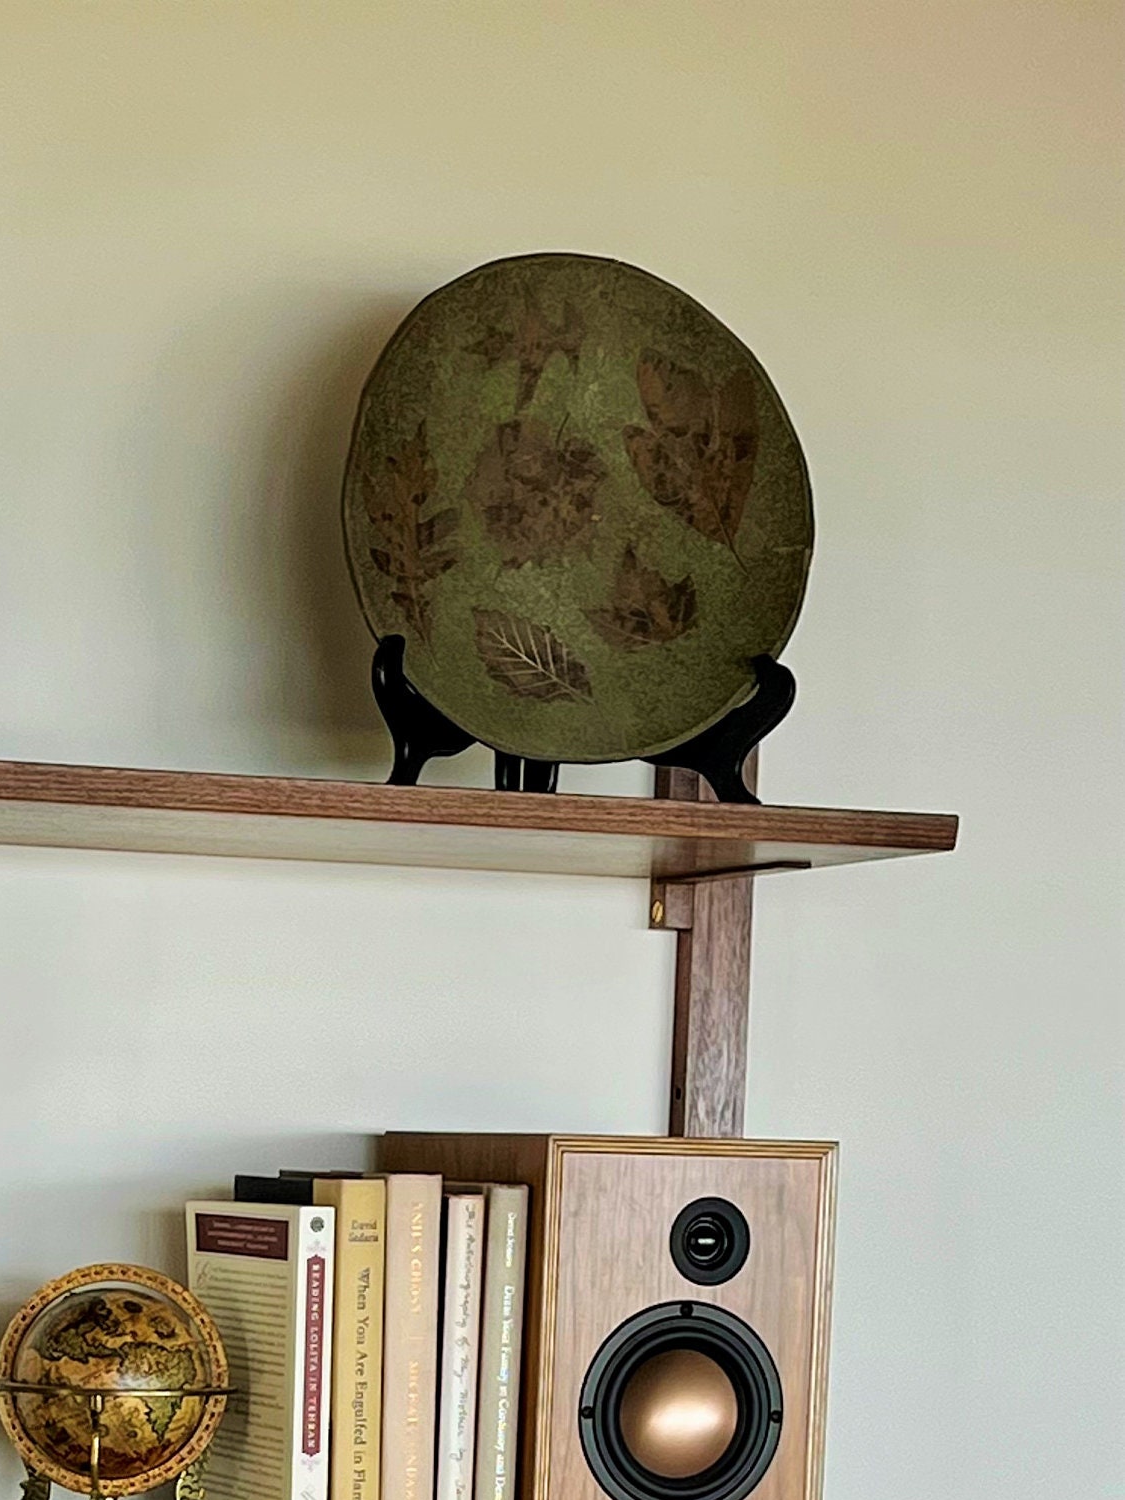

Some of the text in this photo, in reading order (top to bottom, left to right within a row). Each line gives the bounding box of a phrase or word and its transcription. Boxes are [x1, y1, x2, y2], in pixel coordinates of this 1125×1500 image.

[356, 1267, 371, 1311] When
[356, 1315, 370, 1345] You
[307, 1263, 321, 1449] READING LOLITA IN TEHRAN
[355, 1350, 368, 1377] Are
[351, 1381, 368, 1446] Engulfed
[353, 1450, 366, 1465] in
